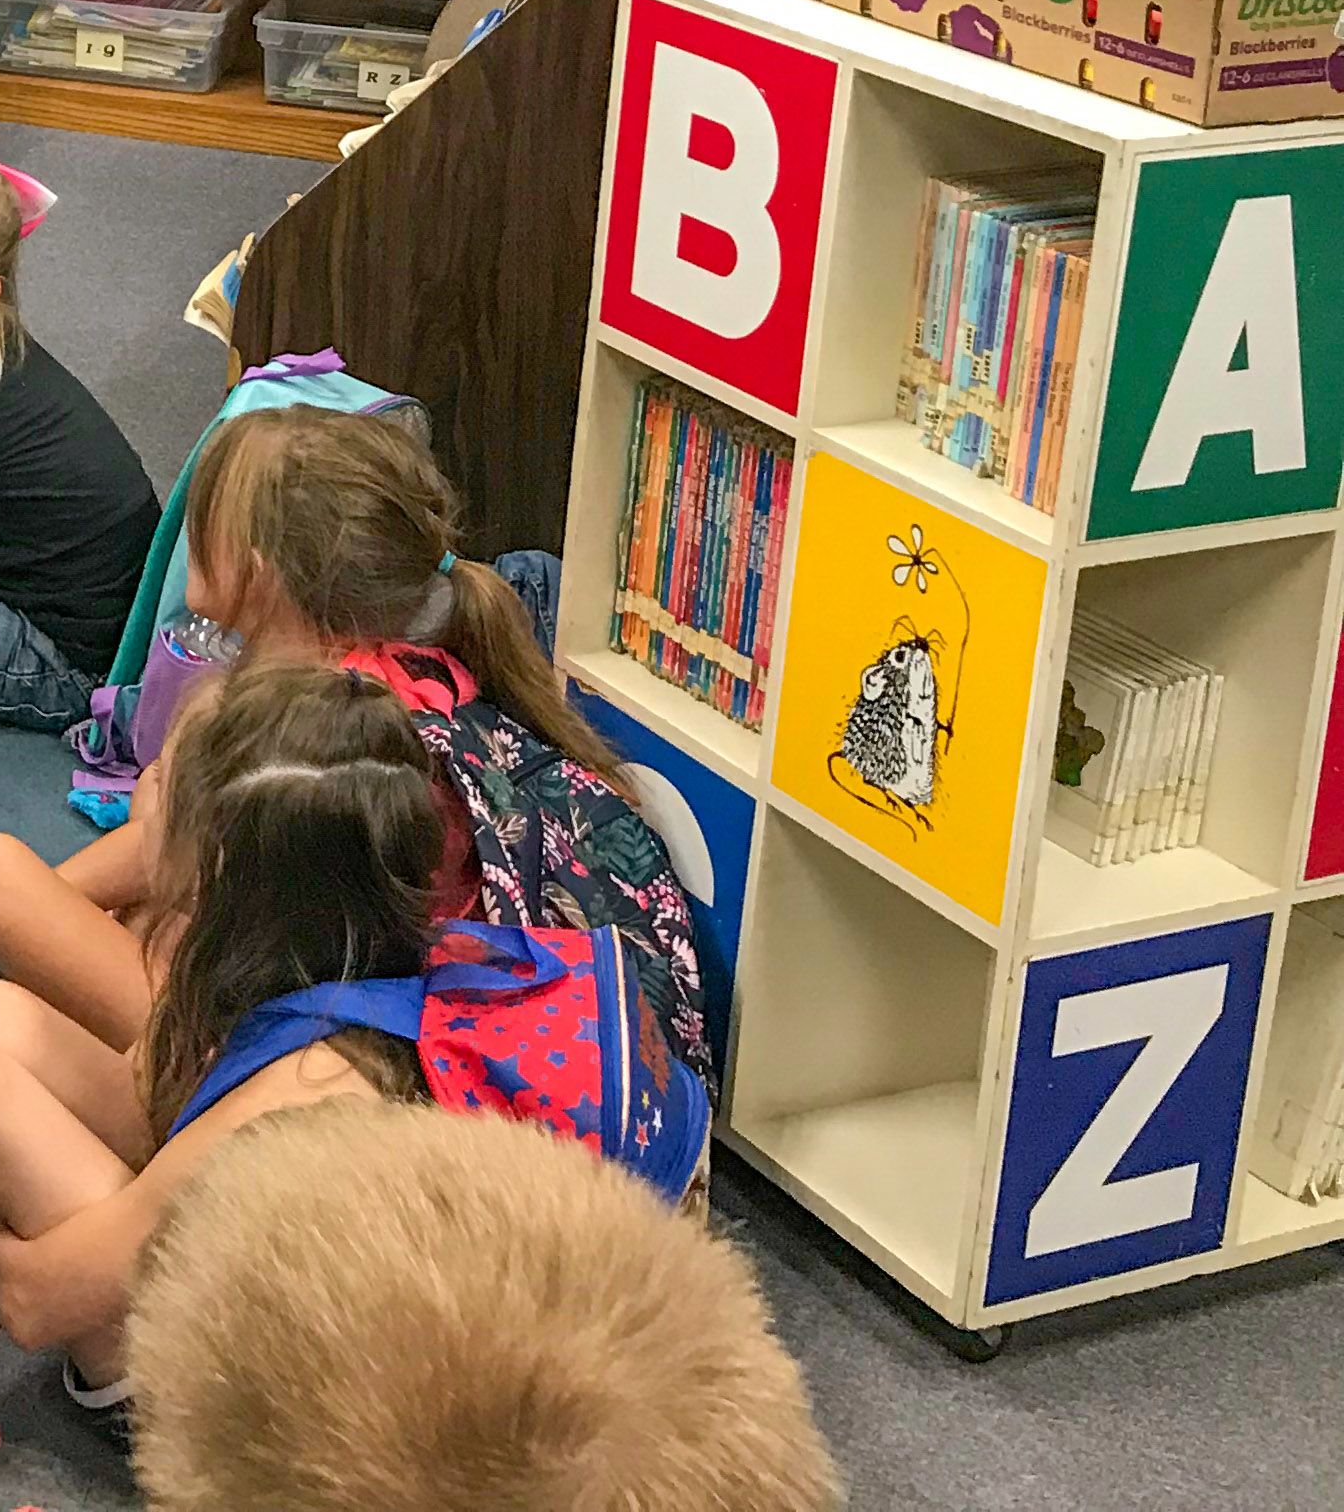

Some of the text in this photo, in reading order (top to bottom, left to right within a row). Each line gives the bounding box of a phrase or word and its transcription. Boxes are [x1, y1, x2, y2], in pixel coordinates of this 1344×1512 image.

[1001, 4, 1092, 44] Blackberries
[1229, 36, 1317, 56] Blackberries
[630, 41, 782, 341] B
[1131, 194, 1308, 492] A
[1023, 963, 1230, 1260] Z
